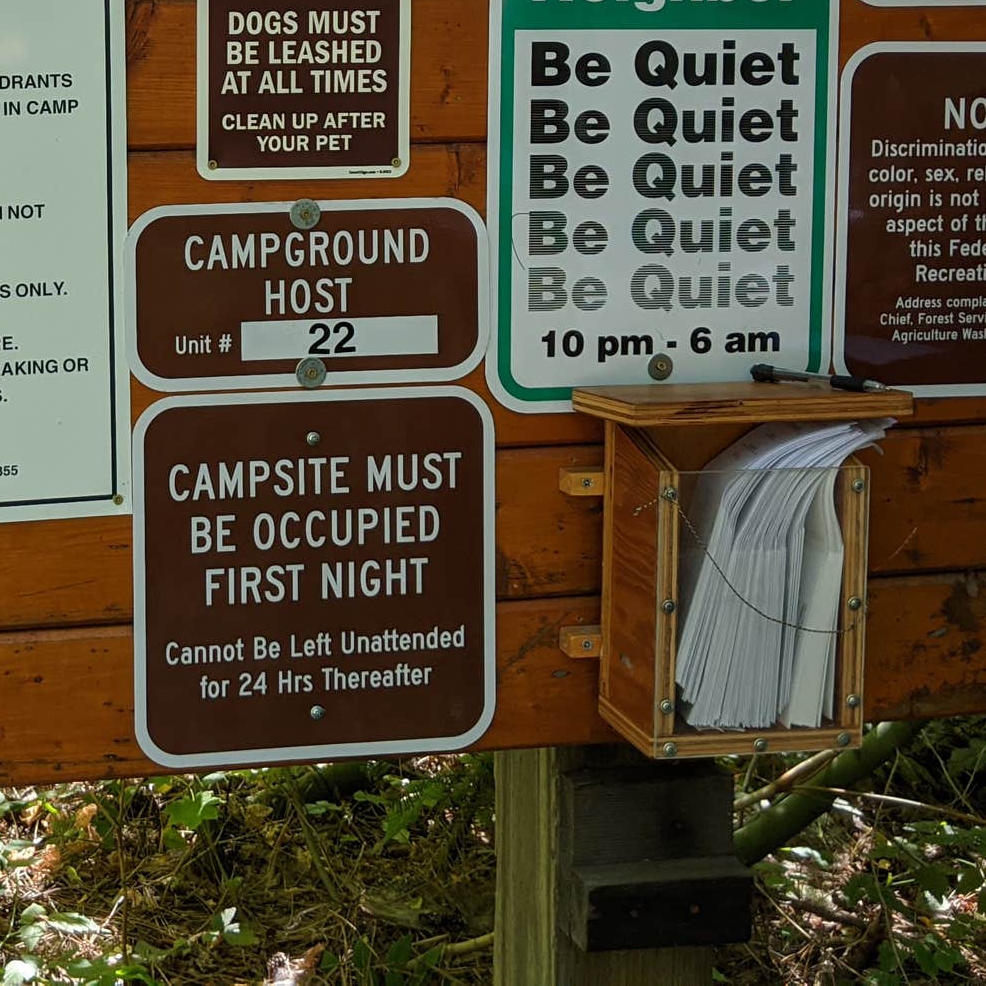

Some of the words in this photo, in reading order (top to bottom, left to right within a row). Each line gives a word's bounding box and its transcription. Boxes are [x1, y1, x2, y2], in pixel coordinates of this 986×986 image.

[228, 11, 298, 35] DOGS
[308, 10, 380, 34] MUST
[226, 41, 259, 65] BE
[268, 39, 382, 64] LEASHED
[531, 41, 611, 87] Be
[634, 39, 800, 90] Quiet
[221, 70, 253, 94] AT
[258, 70, 303, 94] ALL
[309, 69, 388, 94] TIMES
[222, 114, 285, 131] CLEAN
[292, 113, 319, 130] UP
[324, 112, 385, 130] AFTER
[530, 99, 610, 145] Be
[633, 97, 798, 147] Quiet
[257, 136, 309, 152] YOUR
[316, 135, 352, 152] PET
[529, 154, 609, 200] Be
[632, 151, 797, 201] Quiet
[869, 166, 918, 184] color,
[925, 169, 959, 183] sex,
[869, 191, 921, 212] origin
[930, 191, 942, 207] is
[950, 192, 979, 206] not
[528, 210, 609, 256] Be
[631, 207, 796, 257] Quiet
[886, 216, 943, 236] aspect
[951, 215, 968, 232] of
[184, 229, 430, 270] CAMPGROUND
[910, 241, 941, 257] this
[265, 278, 352, 315] HOST
[528, 267, 607, 312] Be
[630, 262, 795, 312] Quiet
[896, 296, 942, 308] Address
[880, 313, 913, 326] Chief,
[918, 312, 953, 324] Forest
[175, 335, 212, 356] Unit
[219, 335, 232, 352] #
[308, 322, 356, 355] 22
[541, 330, 584, 358] 10
[597, 332, 653, 362] pm
[690, 328, 711, 354] 6
[725, 331, 780, 353] am
[892, 328, 958, 345] Agriculture
[169, 457, 350, 502] CAMPSITE
[367, 452, 462, 493] MUST
[191, 515, 236, 554] BE
[253, 505, 440, 550] OCCUPIED
[205, 564, 304, 606] FIRST
[322, 558, 428, 599] NIGHT
[166, 639, 244, 665] Cannot
[254, 637, 280, 660] Be
[290, 633, 331, 658] Left
[341, 624, 465, 655] Unattended
[200, 675, 230, 699] for
[239, 674, 267, 696] 24
[278, 671, 313, 694] Hrs
[322, 664, 432, 692] Thereafter
